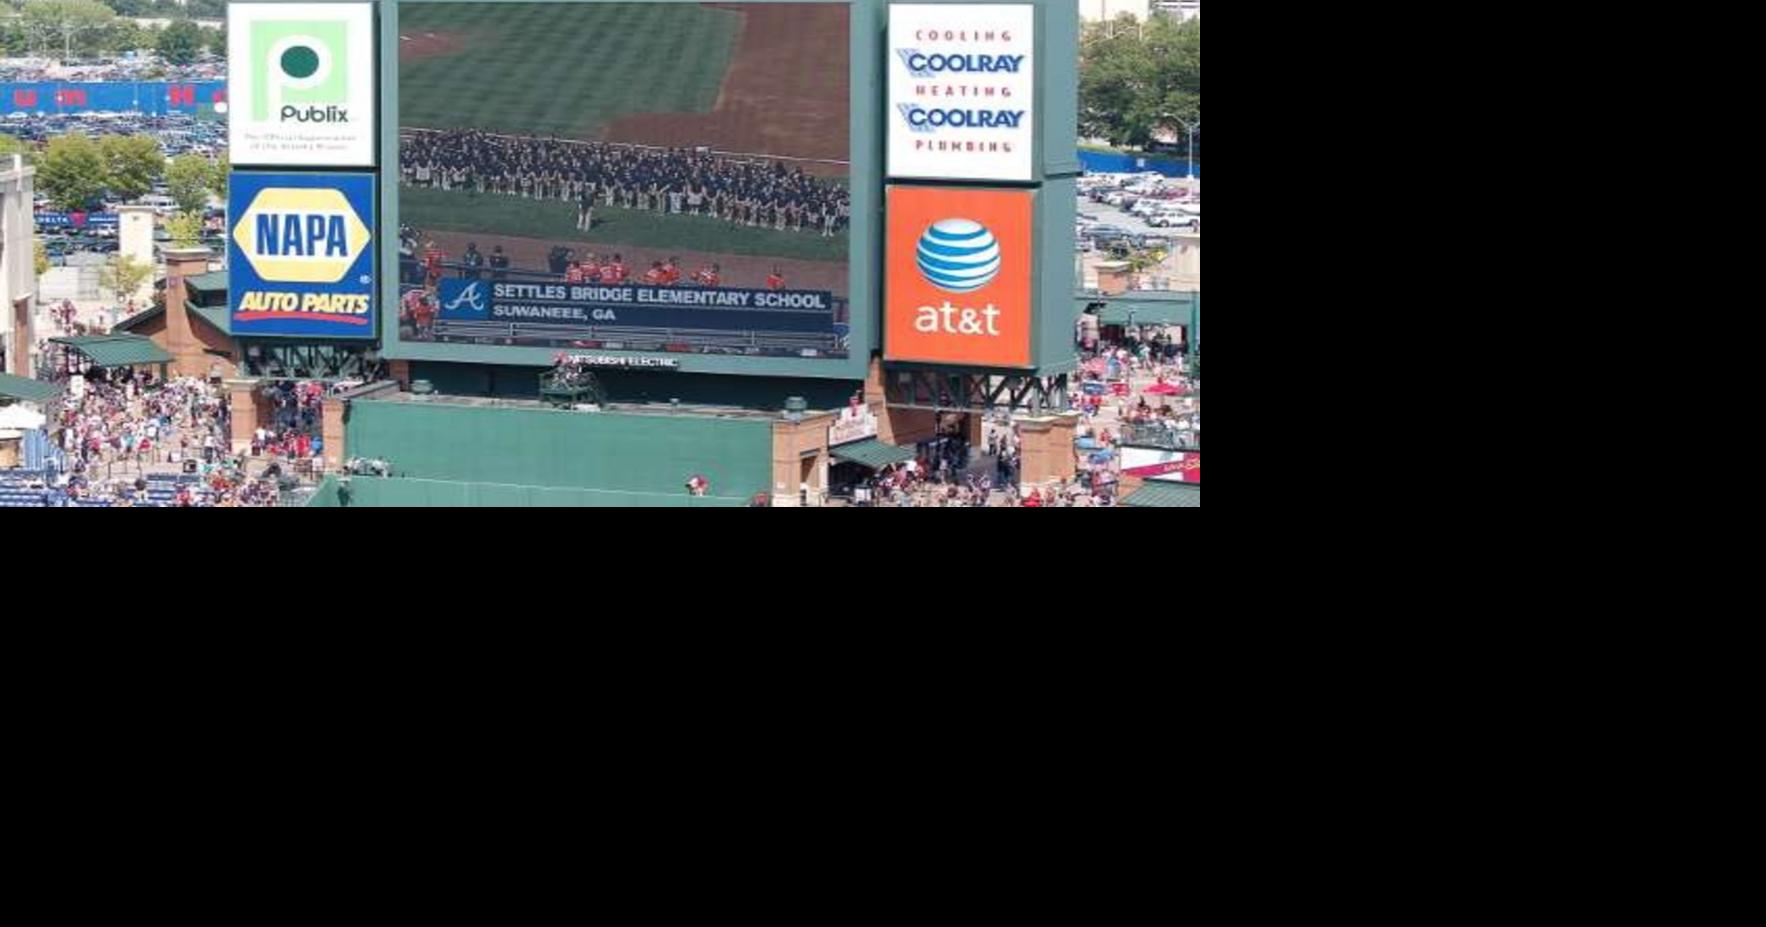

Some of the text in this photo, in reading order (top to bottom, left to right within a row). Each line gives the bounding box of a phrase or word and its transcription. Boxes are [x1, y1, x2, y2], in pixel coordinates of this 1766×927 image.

[915, 30, 1011, 42] COOLING
[908, 53, 1024, 73] COOLRAY
[915, 85, 1011, 97] HEATING
[280, 105, 348, 122] Publix
[908, 108, 1024, 128] COOLRAY
[915, 140, 1011, 152] PLUMBING
[256, 213, 348, 257] NAPA
[239, 291, 370, 314] AUTO PARTS
[493, 284, 826, 309] SETTLES BRIDGE ELEMENTARY SCHOOL
[592, 309, 616, 320] GA
[915, 301, 1001, 336] at&t
